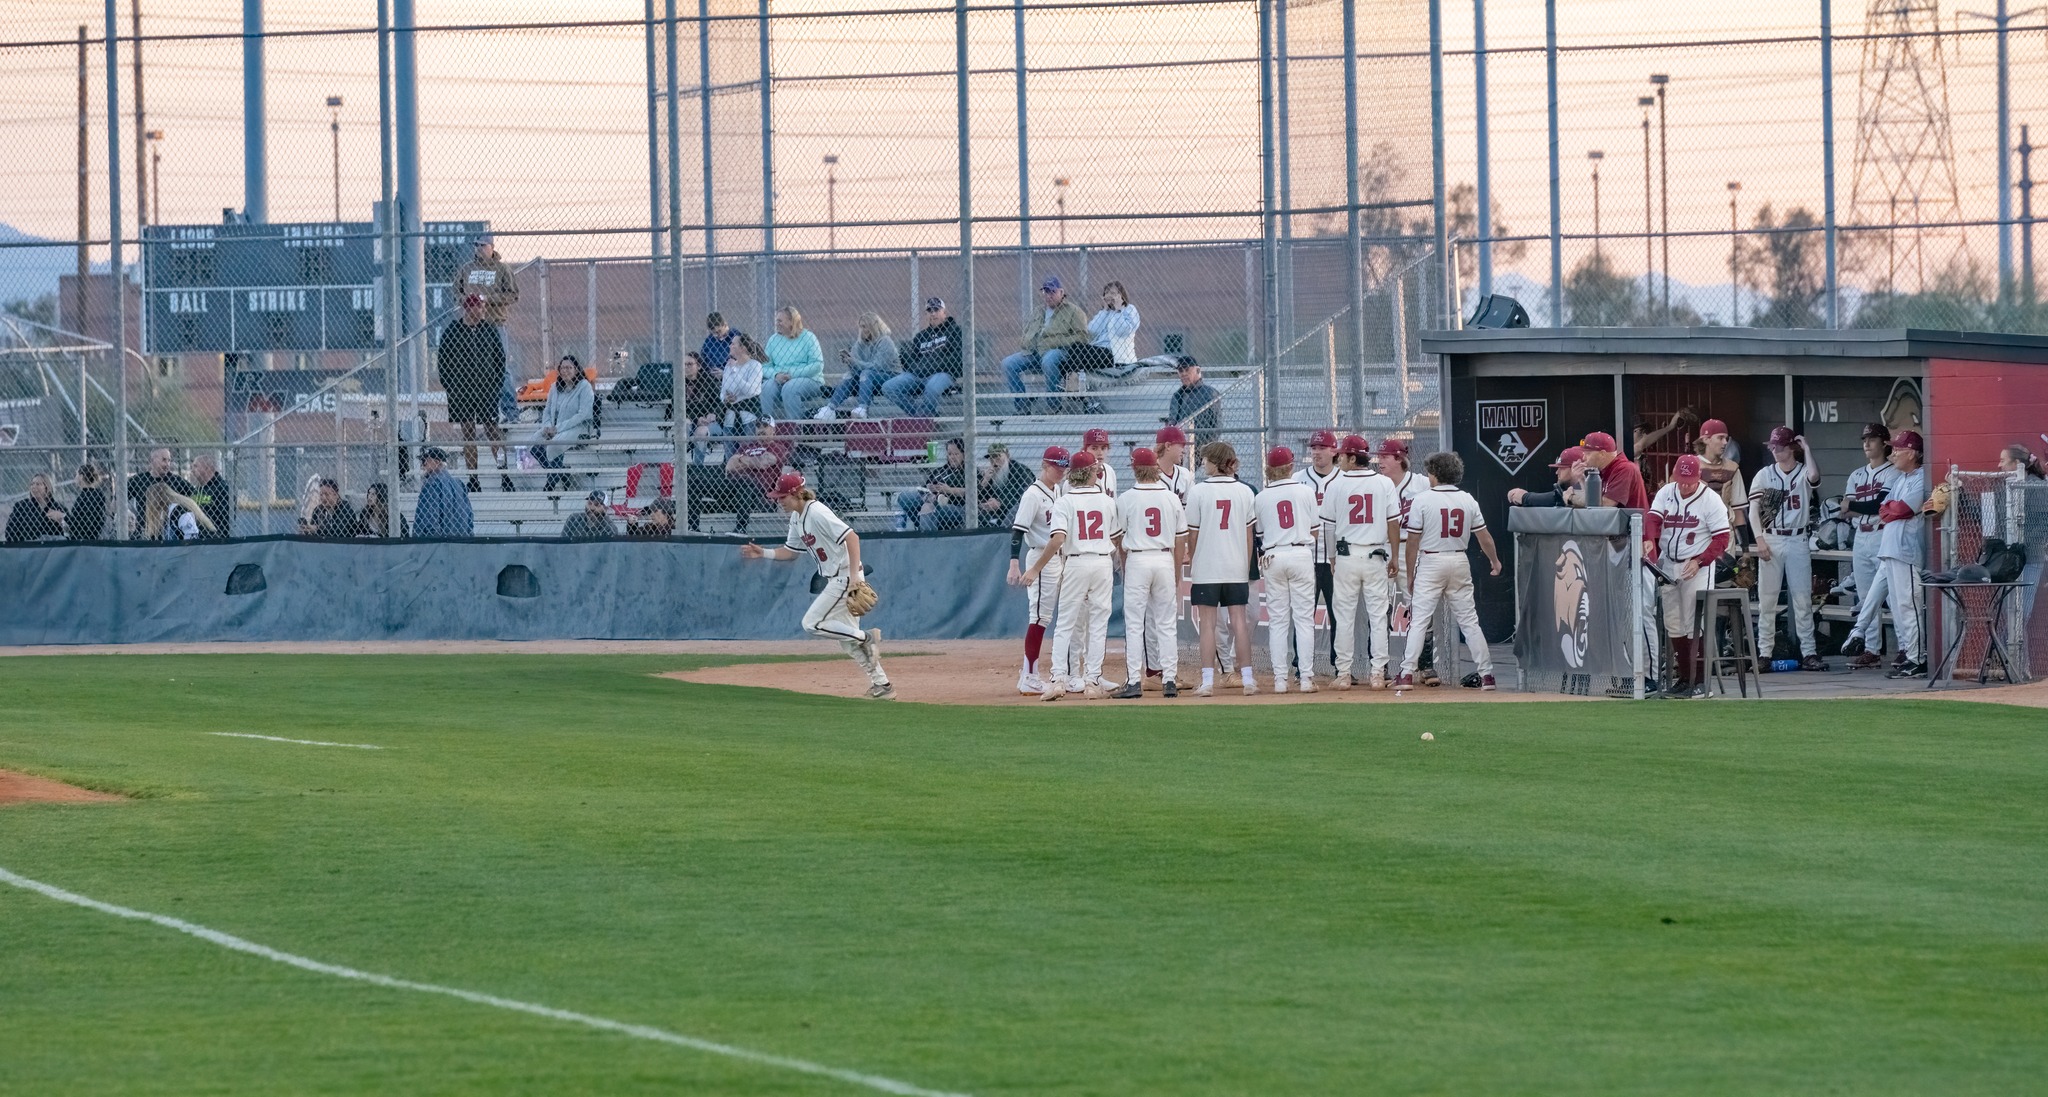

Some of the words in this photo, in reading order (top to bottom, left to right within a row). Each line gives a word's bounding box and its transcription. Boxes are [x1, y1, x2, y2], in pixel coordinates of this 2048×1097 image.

[170, 292, 208, 313] BALL
[250, 290, 305, 311] STRIKE
[352, 289, 373, 310] OU
[1482, 406, 1518, 429] MAN
[1520, 405, 1543, 427] UP
[1216, 499, 1231, 530] 7
[1276, 500, 1295, 530] 8
[1348, 493, 1374, 524] 21
[1787, 494, 1800, 511] 15
[1077, 510, 1104, 540] 12
[1145, 507, 1161, 537] 3
[1440, 508, 1465, 538] 13
